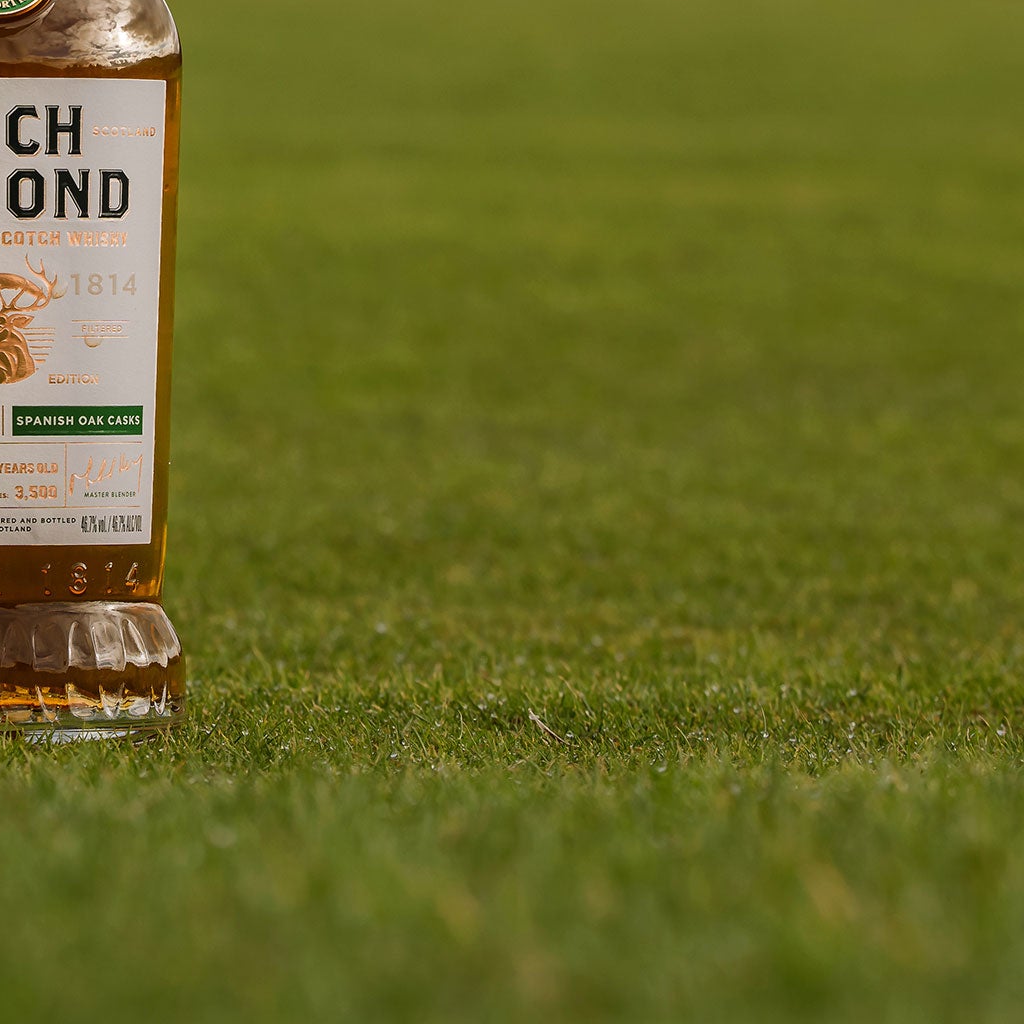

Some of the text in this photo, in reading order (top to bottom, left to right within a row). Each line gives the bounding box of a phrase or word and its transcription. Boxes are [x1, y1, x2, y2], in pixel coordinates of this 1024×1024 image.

[92, 126, 157, 137] SCOTLAND
[67, 230, 129, 247] WHISKY
[70, 273, 137, 296] 1814
[81, 324, 123, 333] FILTERED
[48, 373, 99, 384] EDITION
[16, 415, 141, 426] SPANISH OAK CASKS
[36, 463, 59, 474] OLD
[15, 485, 58, 500] 3,500
[40, 562, 140, 595] 1814
